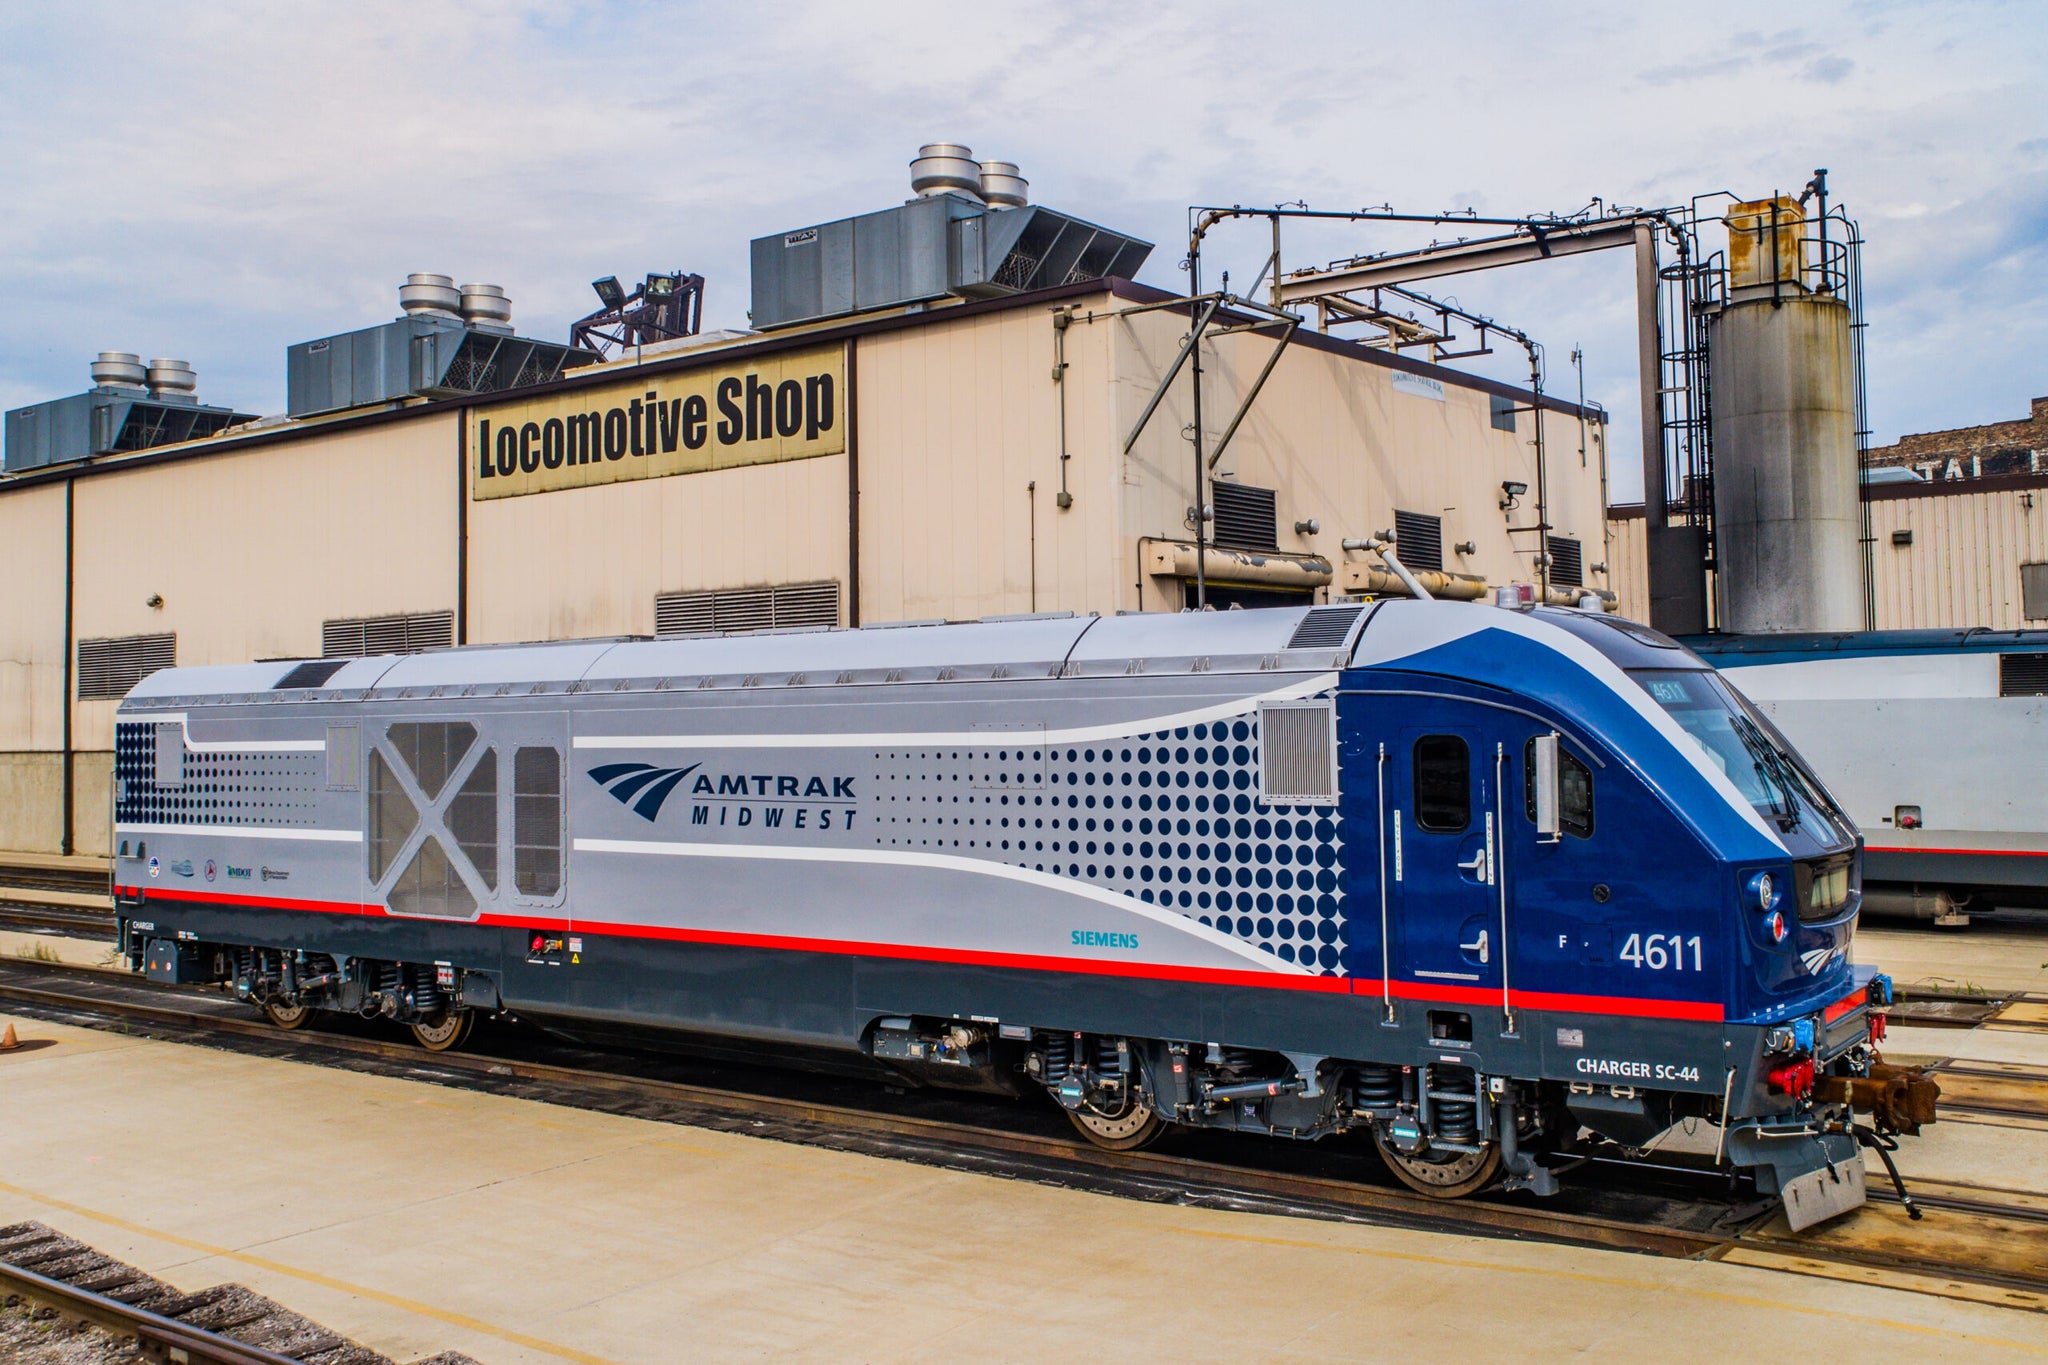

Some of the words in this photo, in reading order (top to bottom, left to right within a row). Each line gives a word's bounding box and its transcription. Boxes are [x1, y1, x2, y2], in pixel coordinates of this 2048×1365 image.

[480, 391, 708, 479] Locomotive
[716, 372, 835, 446] Shop
[691, 774, 857, 798] AMTRAK
[691, 805, 857, 830] MIDWEST
[1071, 930, 1139, 949] SIEMENS
[1559, 935, 1567, 948] F
[1620, 933, 1702, 971] 4611
[1576, 1058, 1651, 1078] CHARGER
[1655, 1064, 1700, 1082] SC-44
